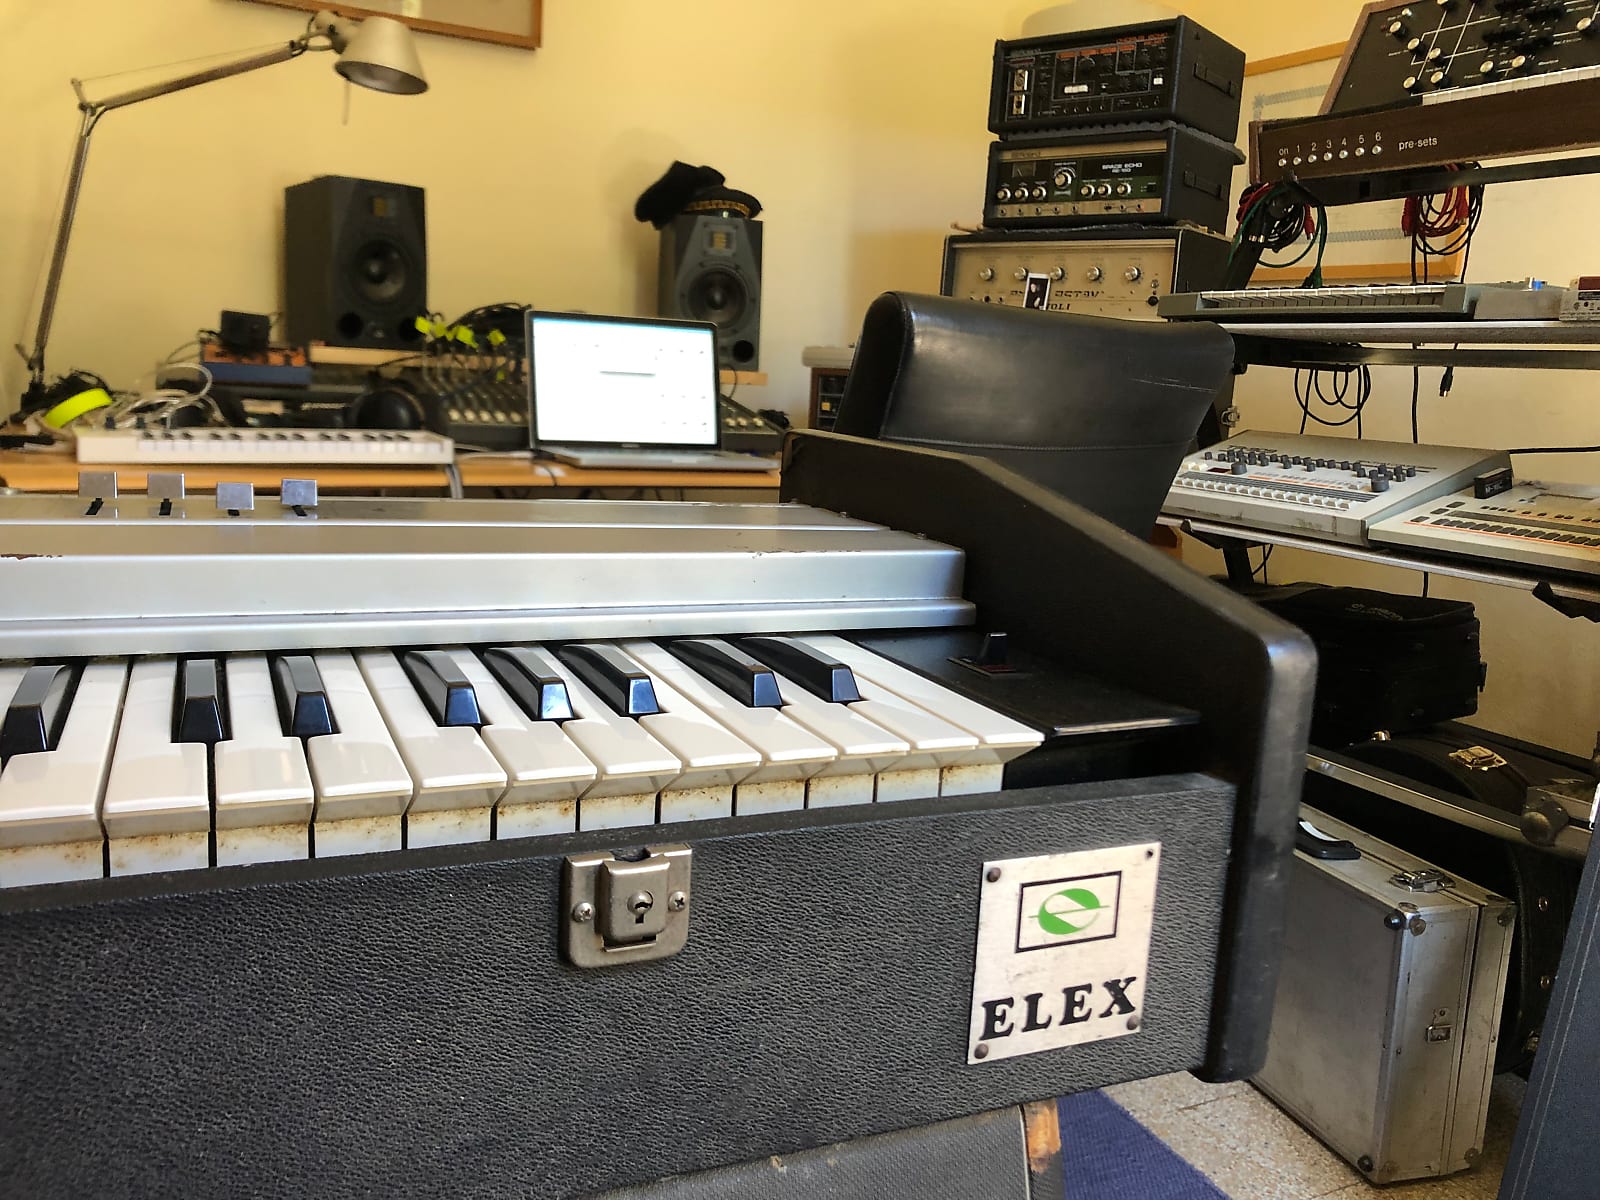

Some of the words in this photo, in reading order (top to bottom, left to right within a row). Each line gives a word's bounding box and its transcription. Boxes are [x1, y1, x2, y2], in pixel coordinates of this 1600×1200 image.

[1297, 144, 1300, 152] 1
[1311, 142, 1317, 151] 2
[1326, 139, 1332, 148] 3
[1341, 137, 1347, 146] 4
[1358, 134, 1365, 144] 5
[1375, 131, 1382, 141] 6
[1398, 137, 1438, 151] pre-sets
[978, 976, 1137, 1041] ELEX
